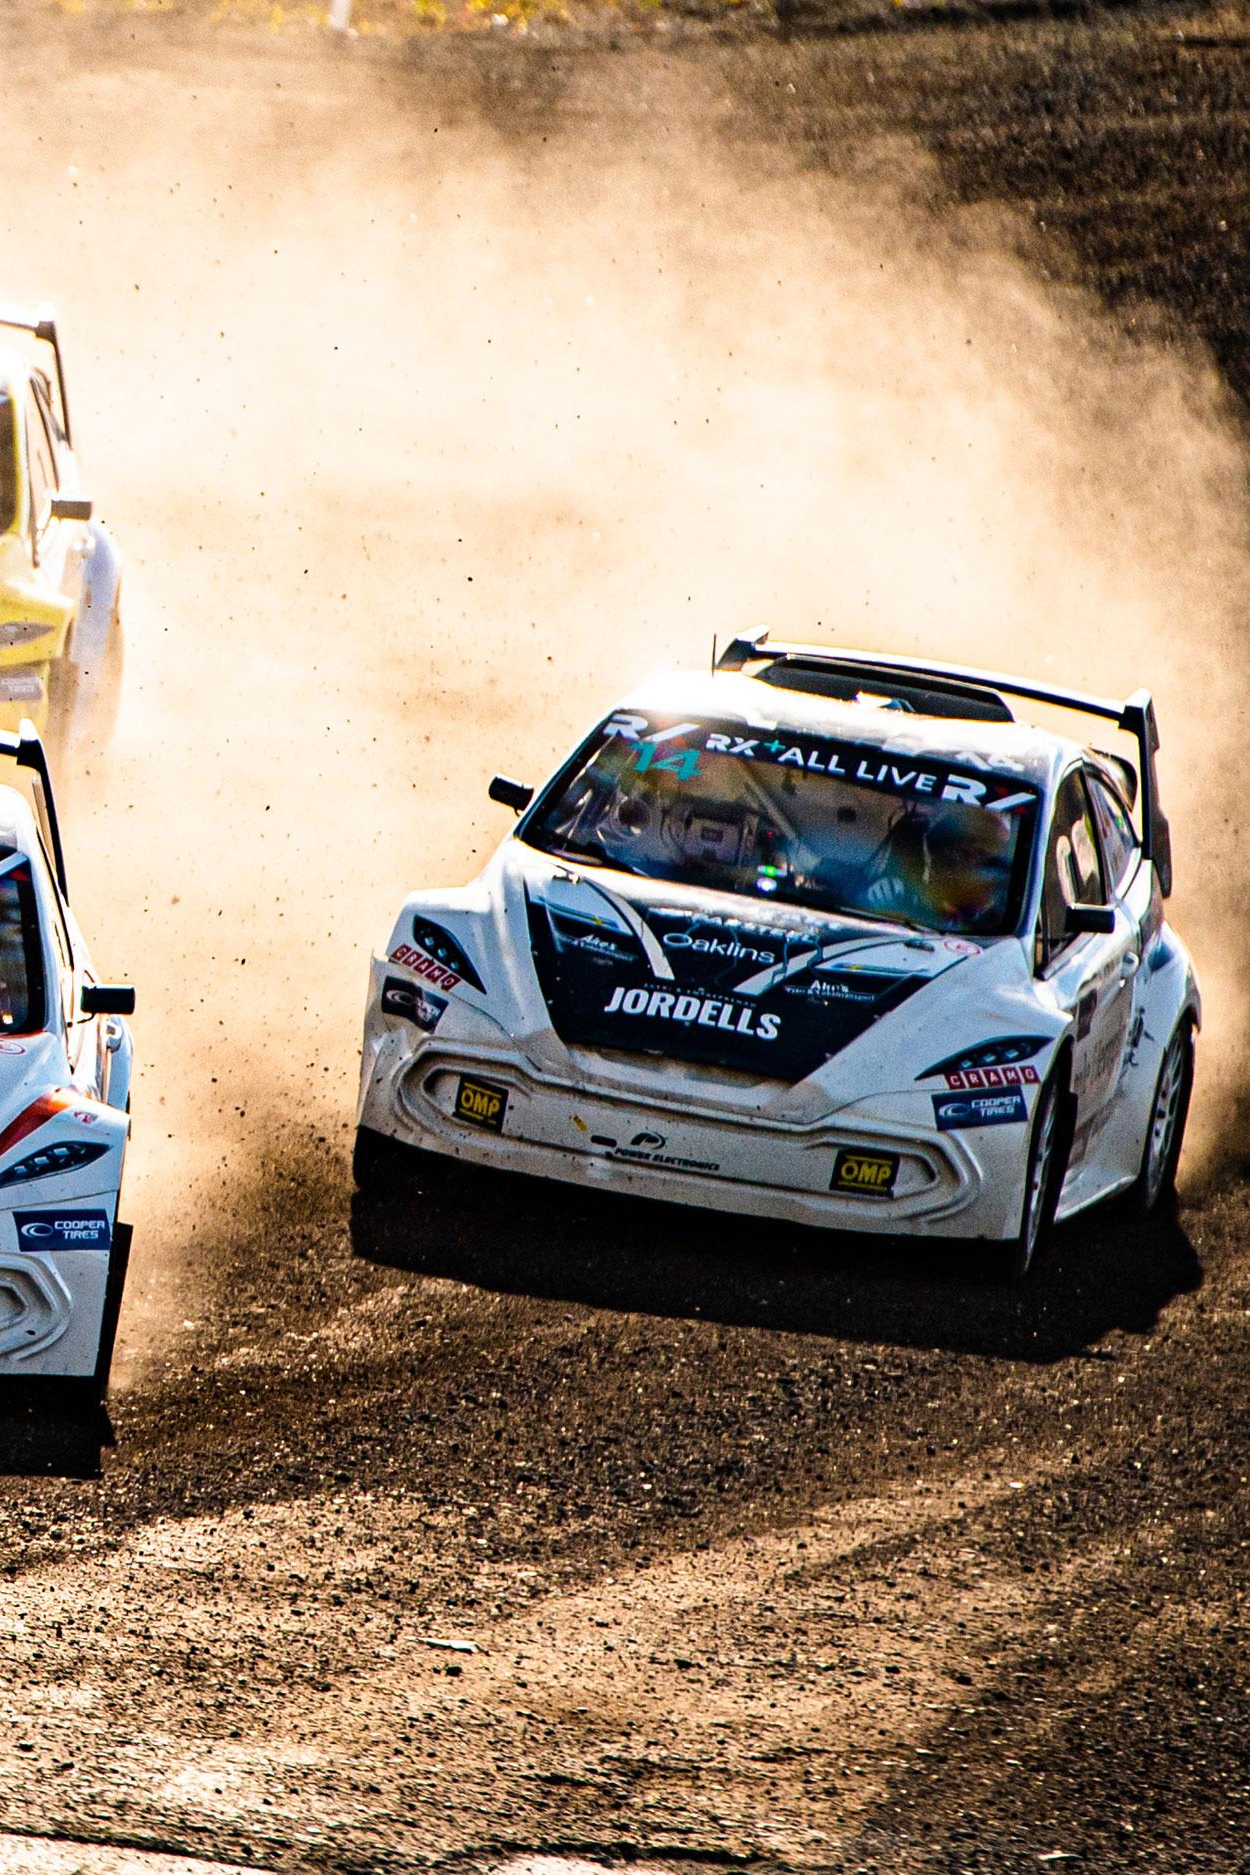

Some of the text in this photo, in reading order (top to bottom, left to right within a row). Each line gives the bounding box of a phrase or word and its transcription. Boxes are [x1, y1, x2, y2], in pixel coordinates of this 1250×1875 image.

[630, 740, 702, 783] 14
[856, 756, 938, 793] LIVE
[663, 933, 776, 964] Oaklins
[604, 986, 782, 1040] JORDELLS
[460, 1090, 502, 1116] OMP
[971, 1095, 1021, 1109] COOPER
[980, 1105, 1015, 1117] TIRES
[841, 1160, 891, 1184] OMP
[54, 1220, 106, 1231] COOPER
[62, 1230, 99, 1240] TIRES
